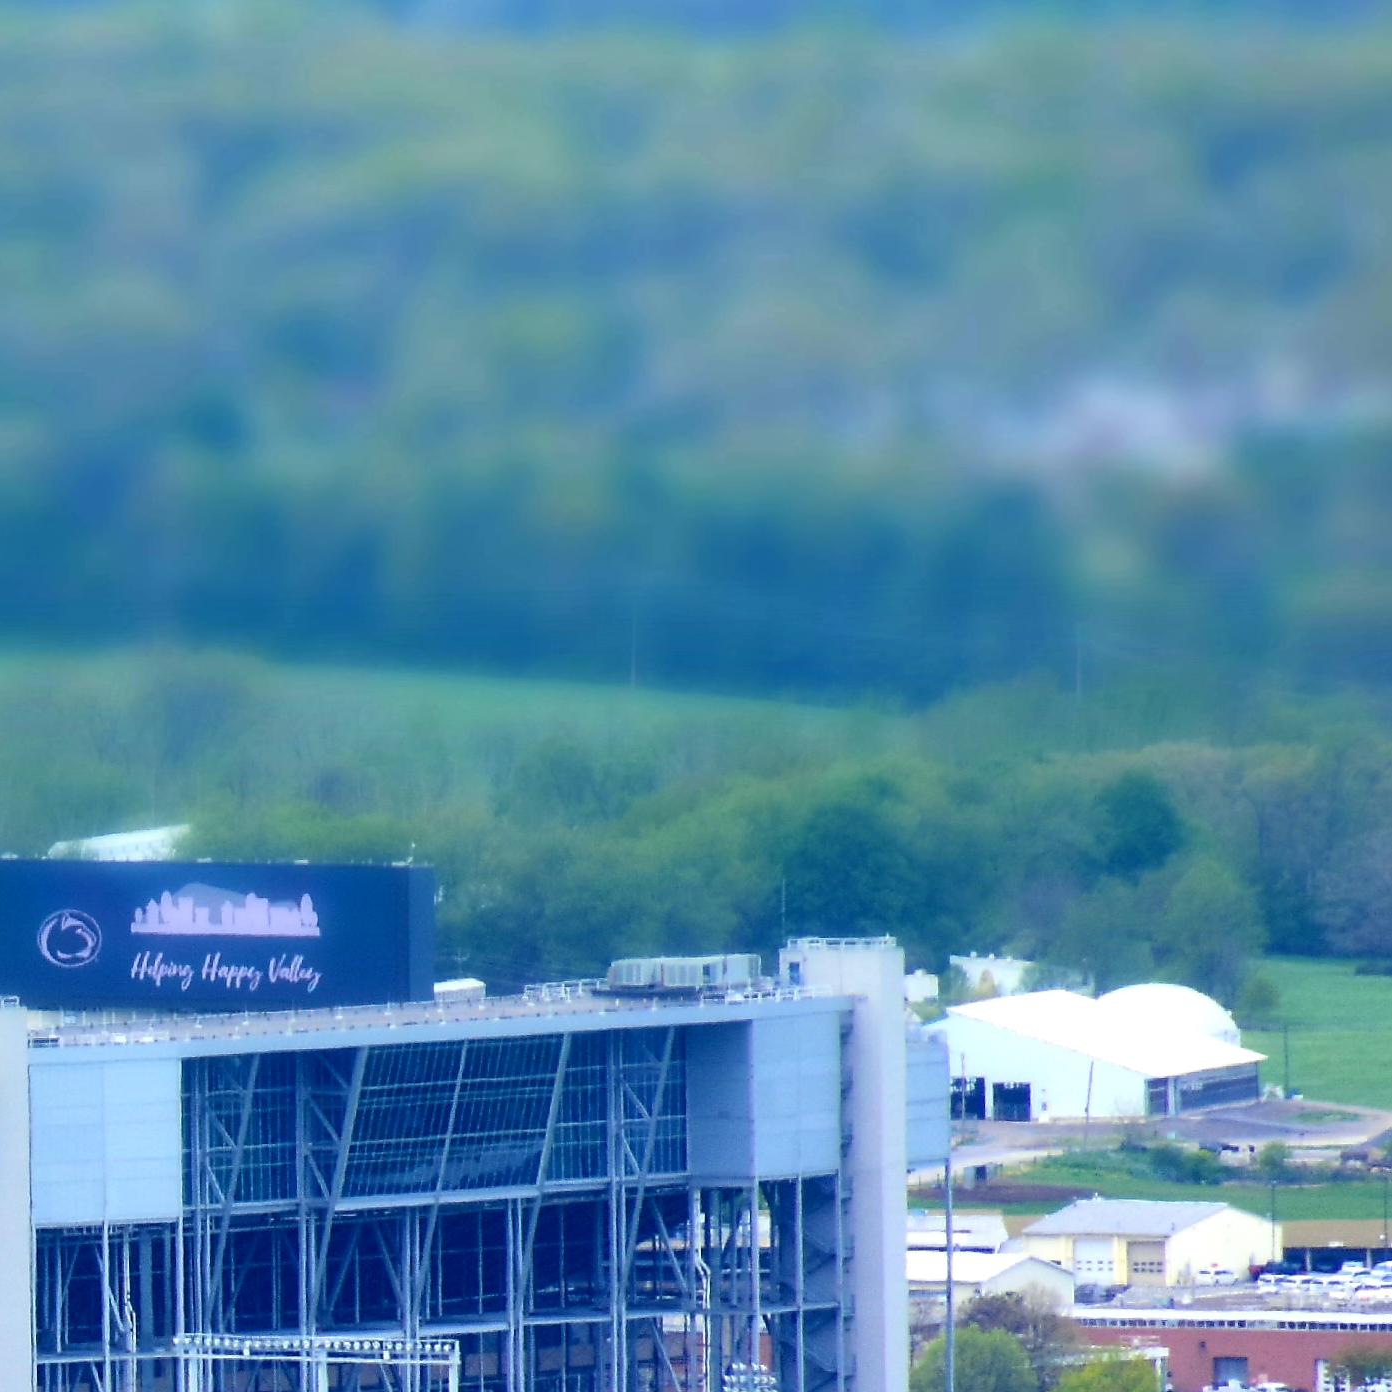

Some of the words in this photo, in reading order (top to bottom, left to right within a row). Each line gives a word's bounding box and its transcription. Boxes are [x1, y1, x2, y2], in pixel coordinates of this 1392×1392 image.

[131, 950, 194, 992] Helping
[201, 951, 263, 992] Happy
[268, 953, 324, 993] Valley
